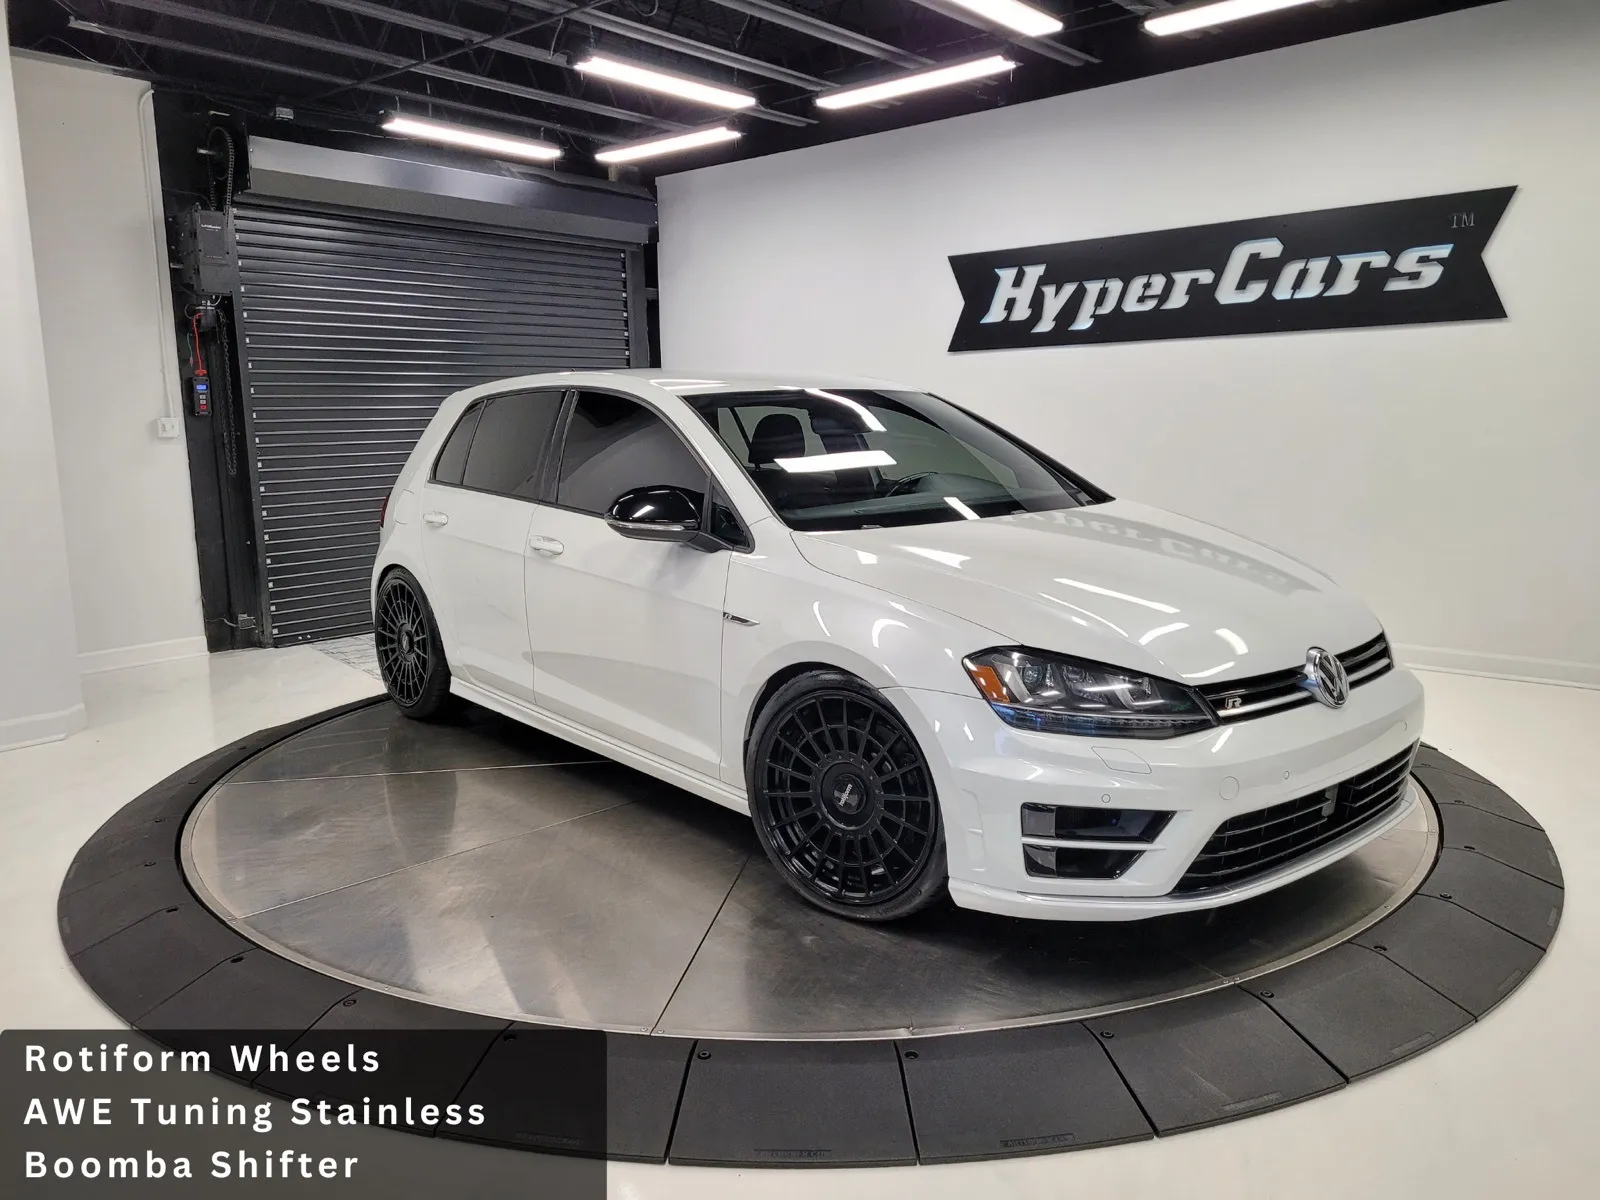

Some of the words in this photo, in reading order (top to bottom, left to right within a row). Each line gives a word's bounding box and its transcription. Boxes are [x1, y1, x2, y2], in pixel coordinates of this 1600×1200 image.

[1451, 212, 1475, 229] TM
[980, 237, 1454, 334] HyperCars
[1225, 696, 1242, 709] R
